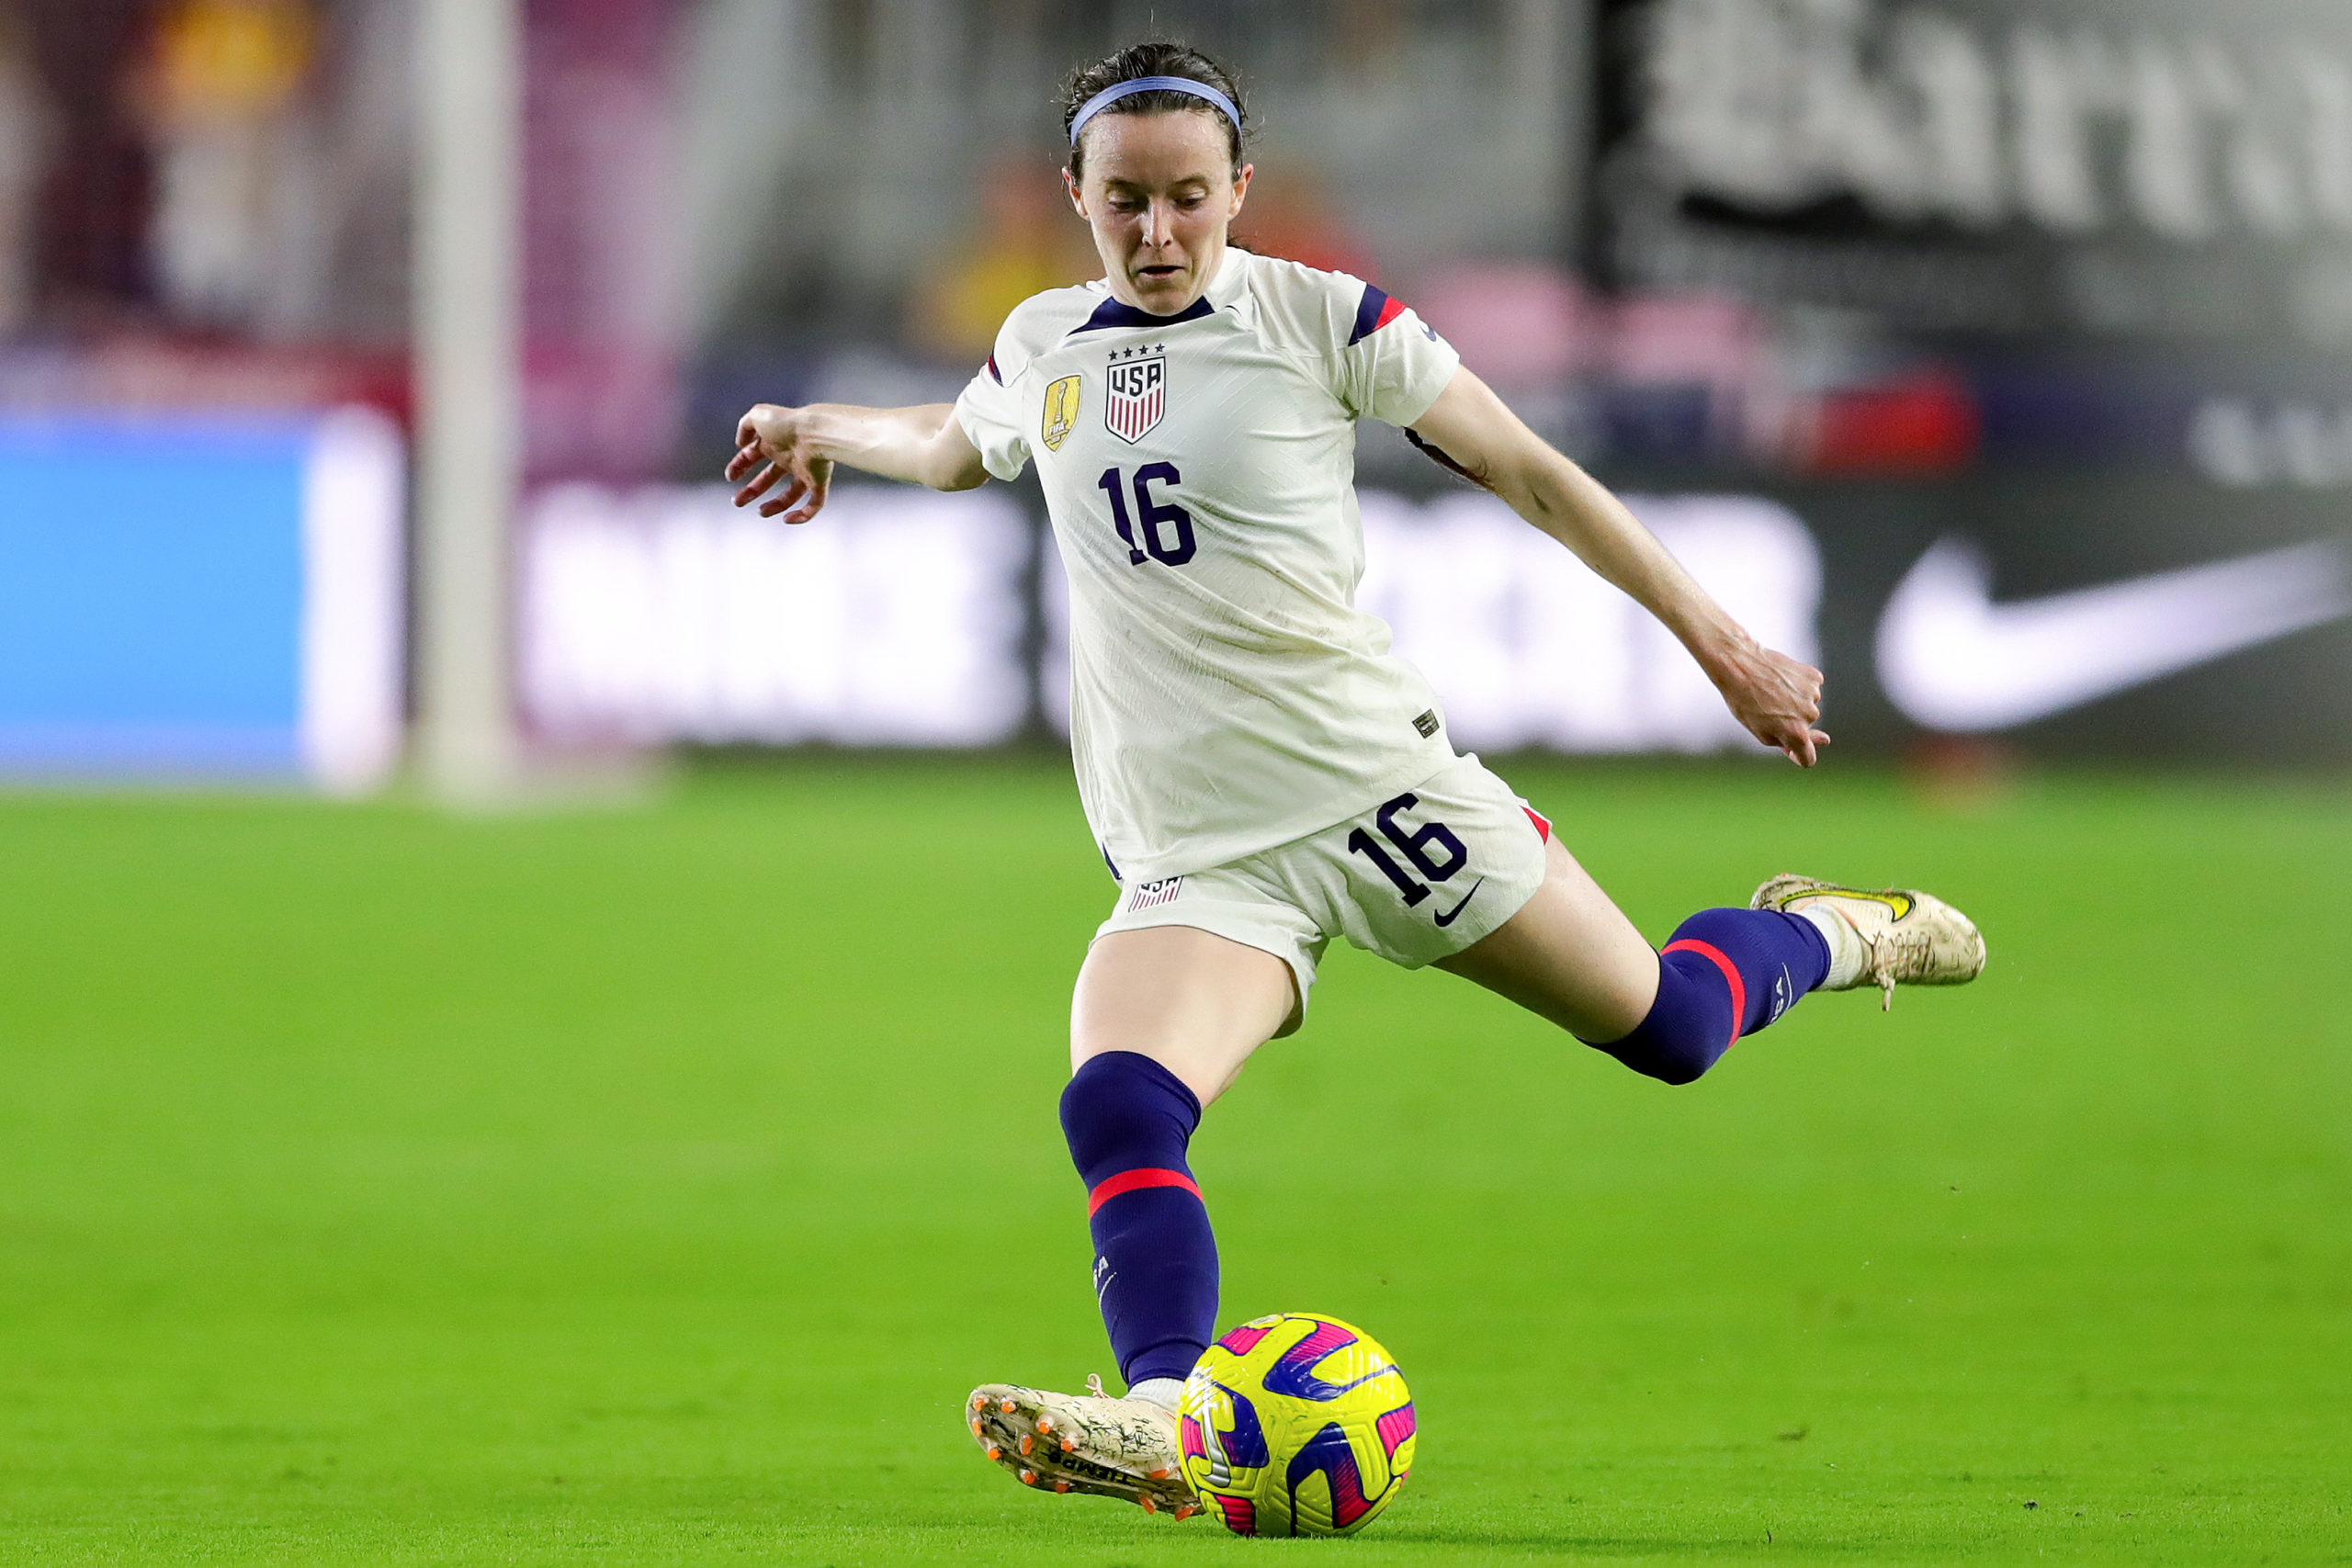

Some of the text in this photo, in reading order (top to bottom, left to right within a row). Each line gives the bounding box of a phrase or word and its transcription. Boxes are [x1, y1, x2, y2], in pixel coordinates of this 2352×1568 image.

[1112, 363, 1161, 396] USA
[1048, 421, 1065, 436] FIFA
[1098, 461, 1197, 567] 16
[1348, 792, 1467, 908] 16
